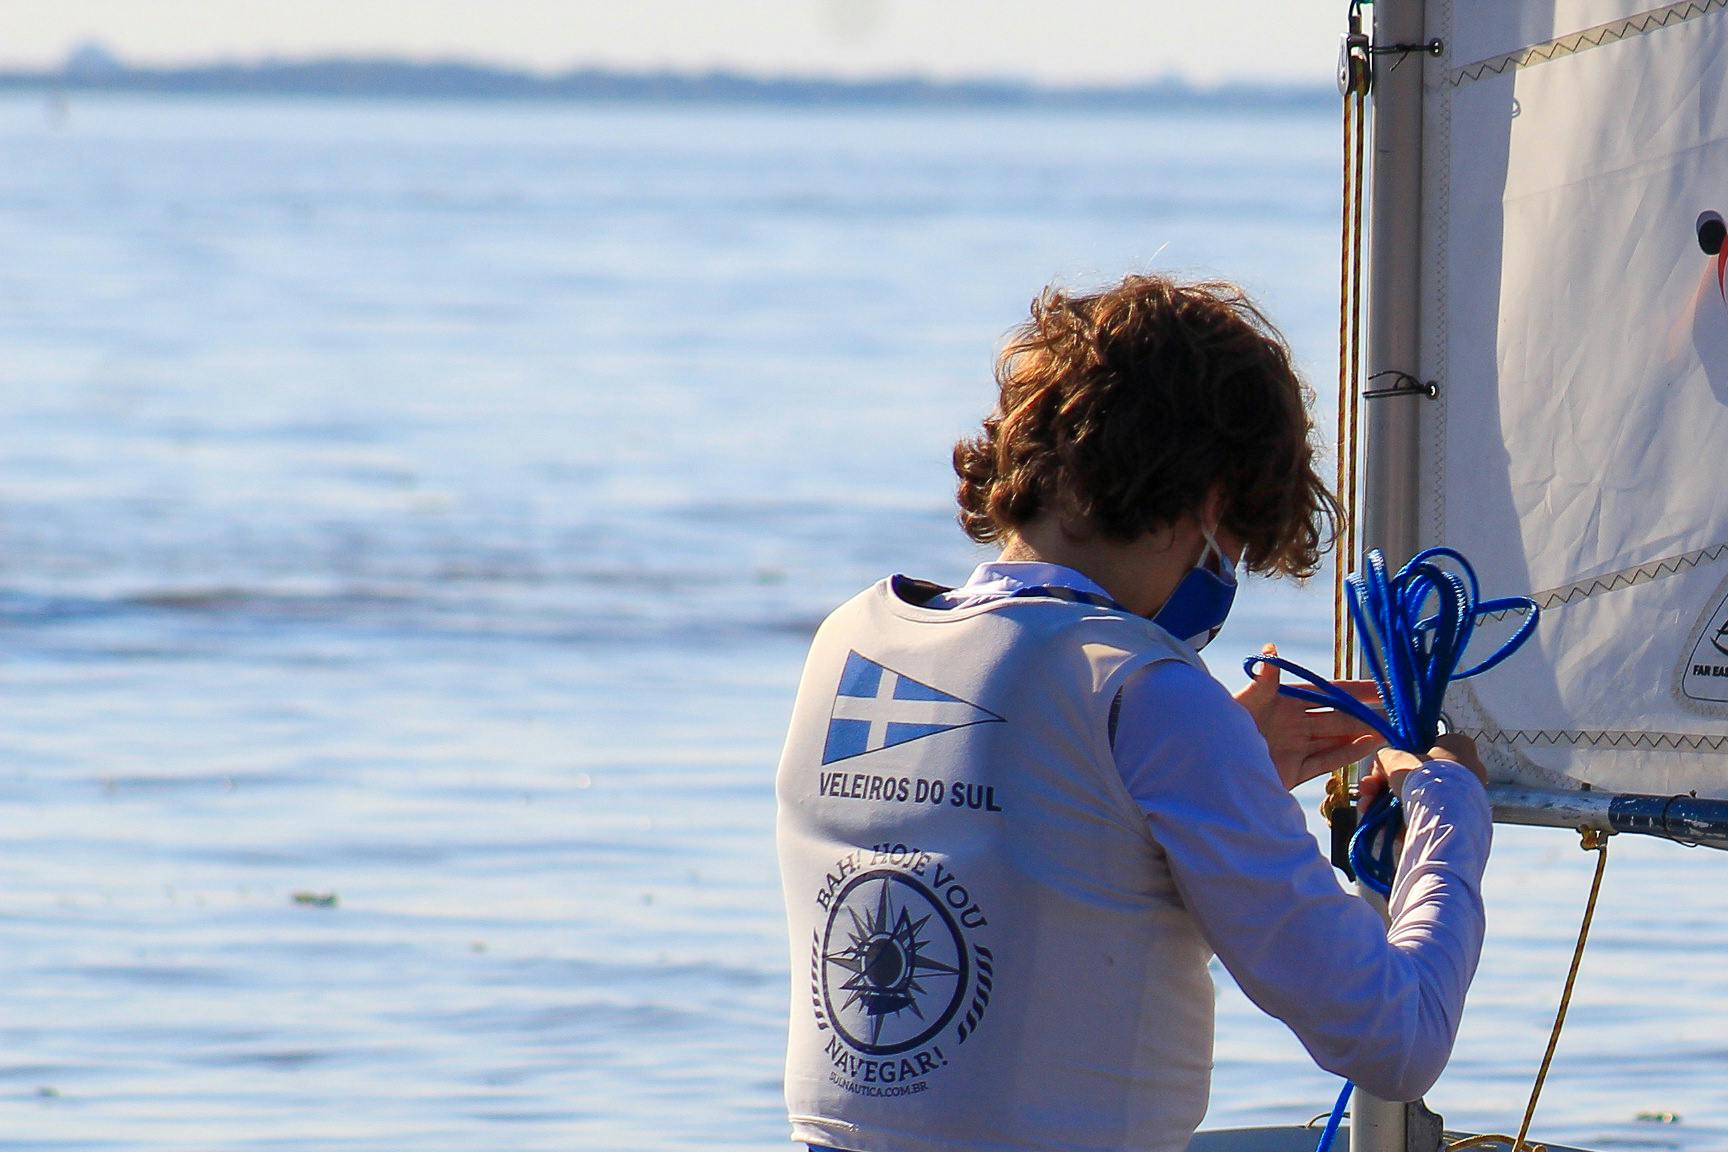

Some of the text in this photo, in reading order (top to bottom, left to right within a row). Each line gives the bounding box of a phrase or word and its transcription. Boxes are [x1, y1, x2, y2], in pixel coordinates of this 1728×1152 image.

[1693, 665, 1712, 676] FAR
[819, 772, 1003, 812] VELEIROS DO SUL
[815, 843, 990, 930] BAH! HOJE VOU
[824, 1035, 949, 1083] NAVEGAR!
[828, 1071, 929, 1098] SULNAUTICA.COM.BR
